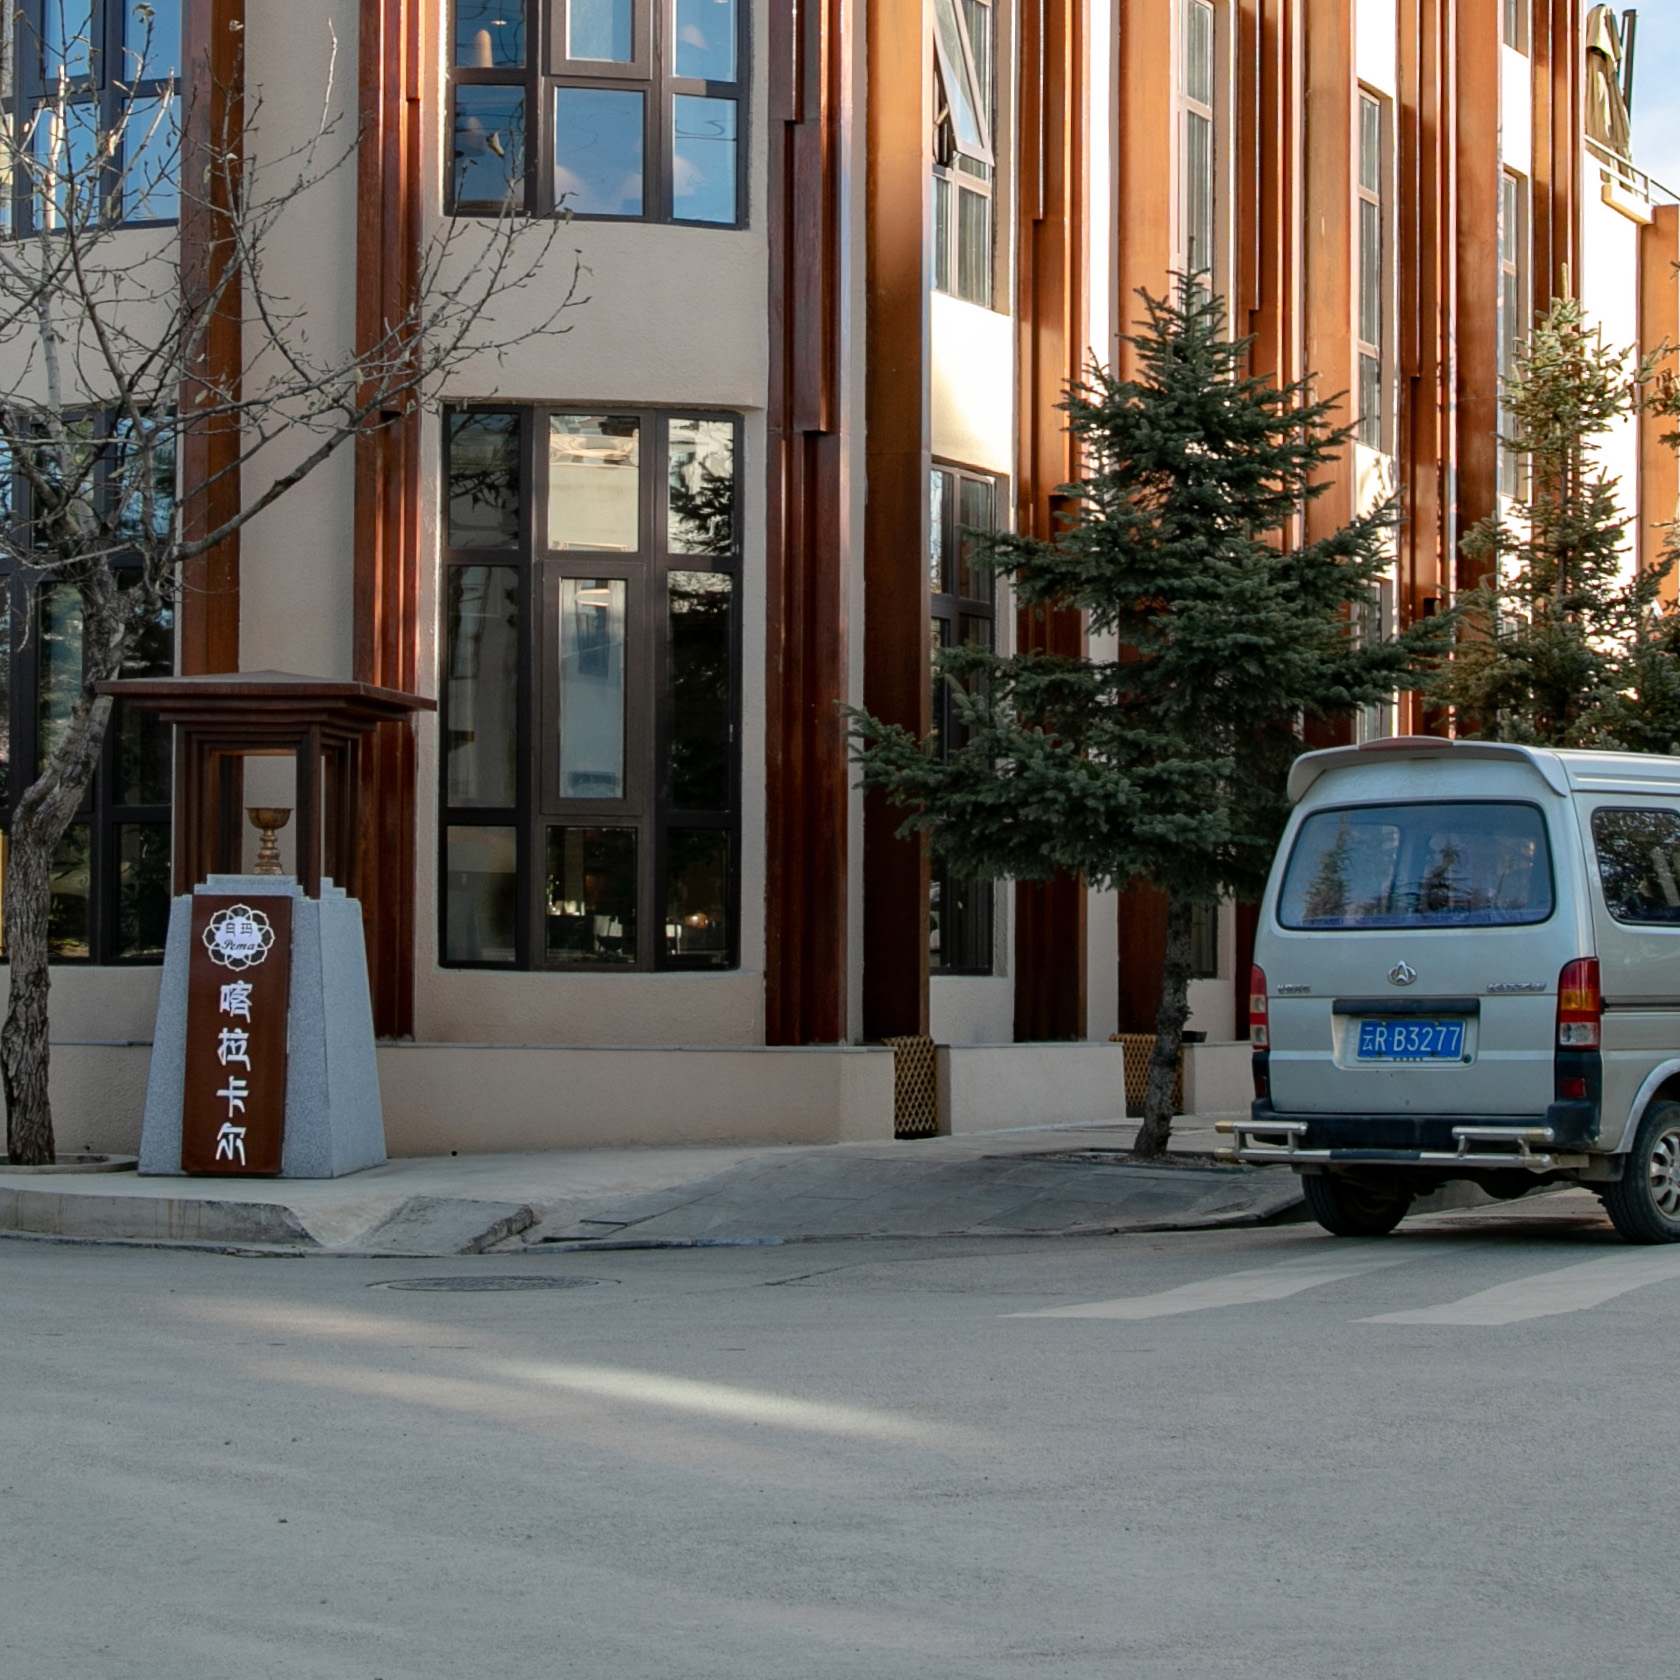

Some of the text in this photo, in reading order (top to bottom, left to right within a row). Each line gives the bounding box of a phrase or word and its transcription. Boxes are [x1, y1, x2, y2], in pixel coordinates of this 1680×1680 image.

[221, 939, 256, 951] Pema
[216, 980, 253, 1166] 喀拉卡尔
